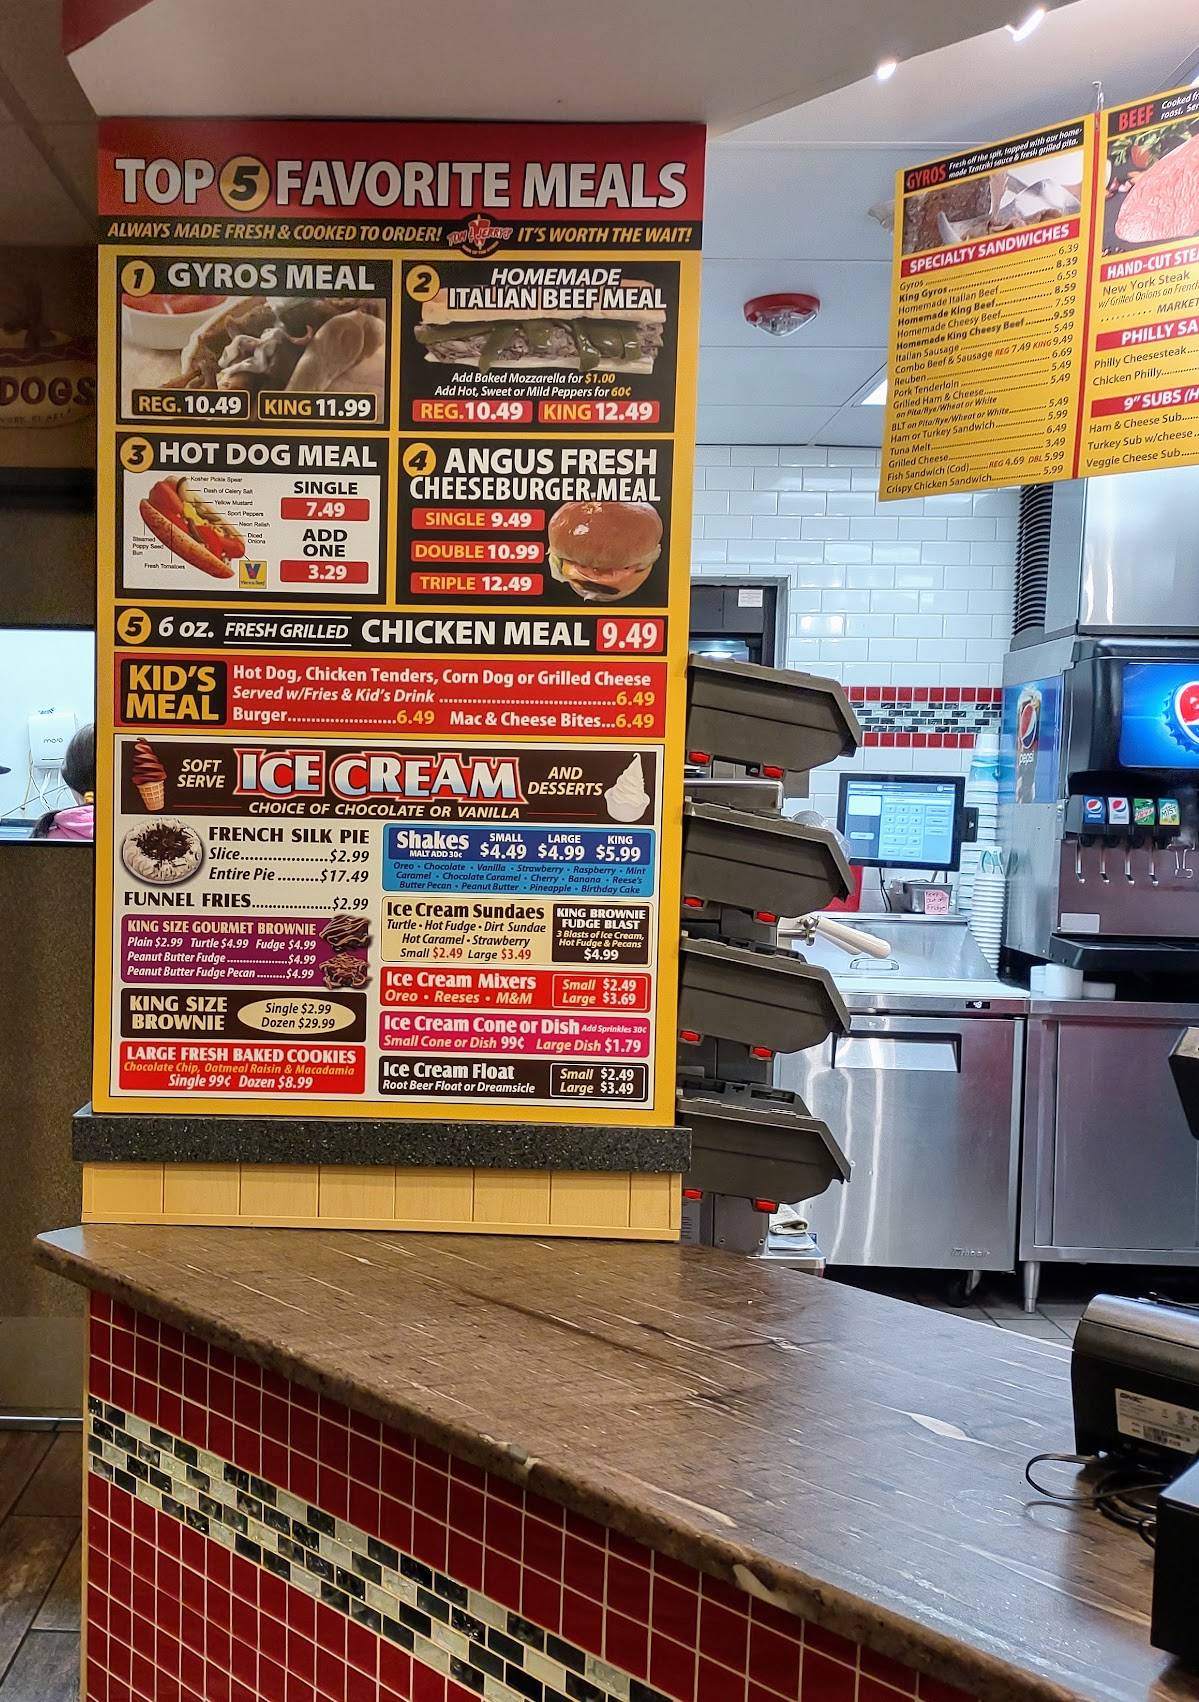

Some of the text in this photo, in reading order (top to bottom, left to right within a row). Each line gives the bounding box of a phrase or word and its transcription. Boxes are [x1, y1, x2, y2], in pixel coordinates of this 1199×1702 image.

[1119, 104, 1154, 131] BEEF
[115, 158, 687, 209] TOP 5 FAVORITE MEALS
[907, 164, 946, 190] GYROS
[108, 222, 170, 238] ALWAYS
[174, 223, 221, 238] MADE
[225, 224, 275, 239] FRESH
[277, 225, 290, 239] &
[294, 225, 356, 241] COOKED
[360, 226, 379, 241] TO
[382, 226, 442, 242] ORDER!
[517, 227, 546, 242] IT'S
[550, 227, 610, 243] WORTH
[613, 228, 642, 243] THE
[645, 228, 692, 243] WAIT!
[910, 224, 1069, 273] SPECIALTY SANDWICHES
[1107, 253, 1172, 280] HAND-CUT
[167, 262, 375, 290] GYROS MEAL
[491, 268, 621, 286] HOMEMADE
[1103, 270, 1191, 297] New York Steak
[449, 288, 667, 309] ITALIAN BEEF MEAL
[1121, 323, 1174, 345] PHILLY
[895, 361, 925, 374] Combo
[927, 355, 946, 368] Beef
[957, 350, 993, 364] Sausage
[1011, 343, 1031, 353] 7.49
[1033, 340, 1051, 349] KING
[1053, 334, 1073, 345] 9.49
[452, 372, 616, 385] Add Baked Mozzarella for $1.00
[1093, 374, 1131, 386] Chicken
[435, 386, 455, 396] Add
[458, 386, 479, 398] Hot,
[481, 386, 512, 397] Sweet
[514, 389, 525, 397] or
[527, 386, 549, 397] Mild
[551, 387, 592, 400] Peppers
[594, 387, 610, 398] for
[1142, 389, 1181, 408] SUBS
[138, 396, 242, 414] REG. 10.49
[264, 399, 372, 417] KING 11.99
[421, 402, 523, 420] REG. 10.49
[543, 402, 653, 420] KING 12.49
[1089, 416, 1159, 433] Ham Cheese
[1088, 430, 1192, 450] Turkey Sub w/cheese
[160, 442, 377, 468] HOT DOG MEAL
[444, 448, 657, 475] ANGUS FRESH
[294, 481, 358, 495] SINGLE
[409, 477, 661, 501] CHEESEBURGER MEAL
[306, 502, 345, 518] 7.49
[425, 512, 532, 528] SINGLE 9.49
[302, 529, 348, 542] ADD
[303, 544, 346, 558] ONE
[415, 544, 539, 560] DOUBLE 10.99
[308, 565, 347, 580] 3.29
[420, 576, 532, 591] TRIPLE 12.49
[158, 617, 174, 637] 6
[225, 622, 348, 639] FRESH GRILLED
[361, 619, 657, 649] CHICKEN MEAL 9.49
[233, 666, 651, 687] Hot Dog, Chicken Tenders, Corn Dog or Grilled Cheese
[126, 694, 218, 721] MEAL
[182, 759, 222, 772] SOFT
[548, 767, 582, 780] AND
[177, 775, 225, 788] SERVE
[240, 752, 519, 800] ICE CREAM
[528, 783, 603, 796] DESSERTS
[249, 802, 520, 819] CHOICE OF CHOCOLATE OR VANILLA
[209, 827, 370, 844] FRENCH SILK PIE
[397, 831, 470, 850] Shakes
[489, 833, 634, 845] SMALL LARGE KING
[480, 843, 641, 862] $4.49 $4.99 $5.99
[387, 902, 545, 920] Ice Cream Sundaes
[556, 908, 646, 920] KING BROWNIE
[127, 920, 316, 936] KING SIZE GOURMET BROWNIE
[562, 919, 640, 930] FUDGE BLAST
[127, 937, 183, 949] Plain $2.99
[386, 971, 537, 990] Ice Cream Mixers
[129, 995, 228, 1013] KING SIZE
[131, 1014, 225, 1030] BROWNIE
[126, 1046, 356, 1064] LARGE FRESH BAKED COOKIES
[383, 1062, 515, 1080] Ice Cream Float
